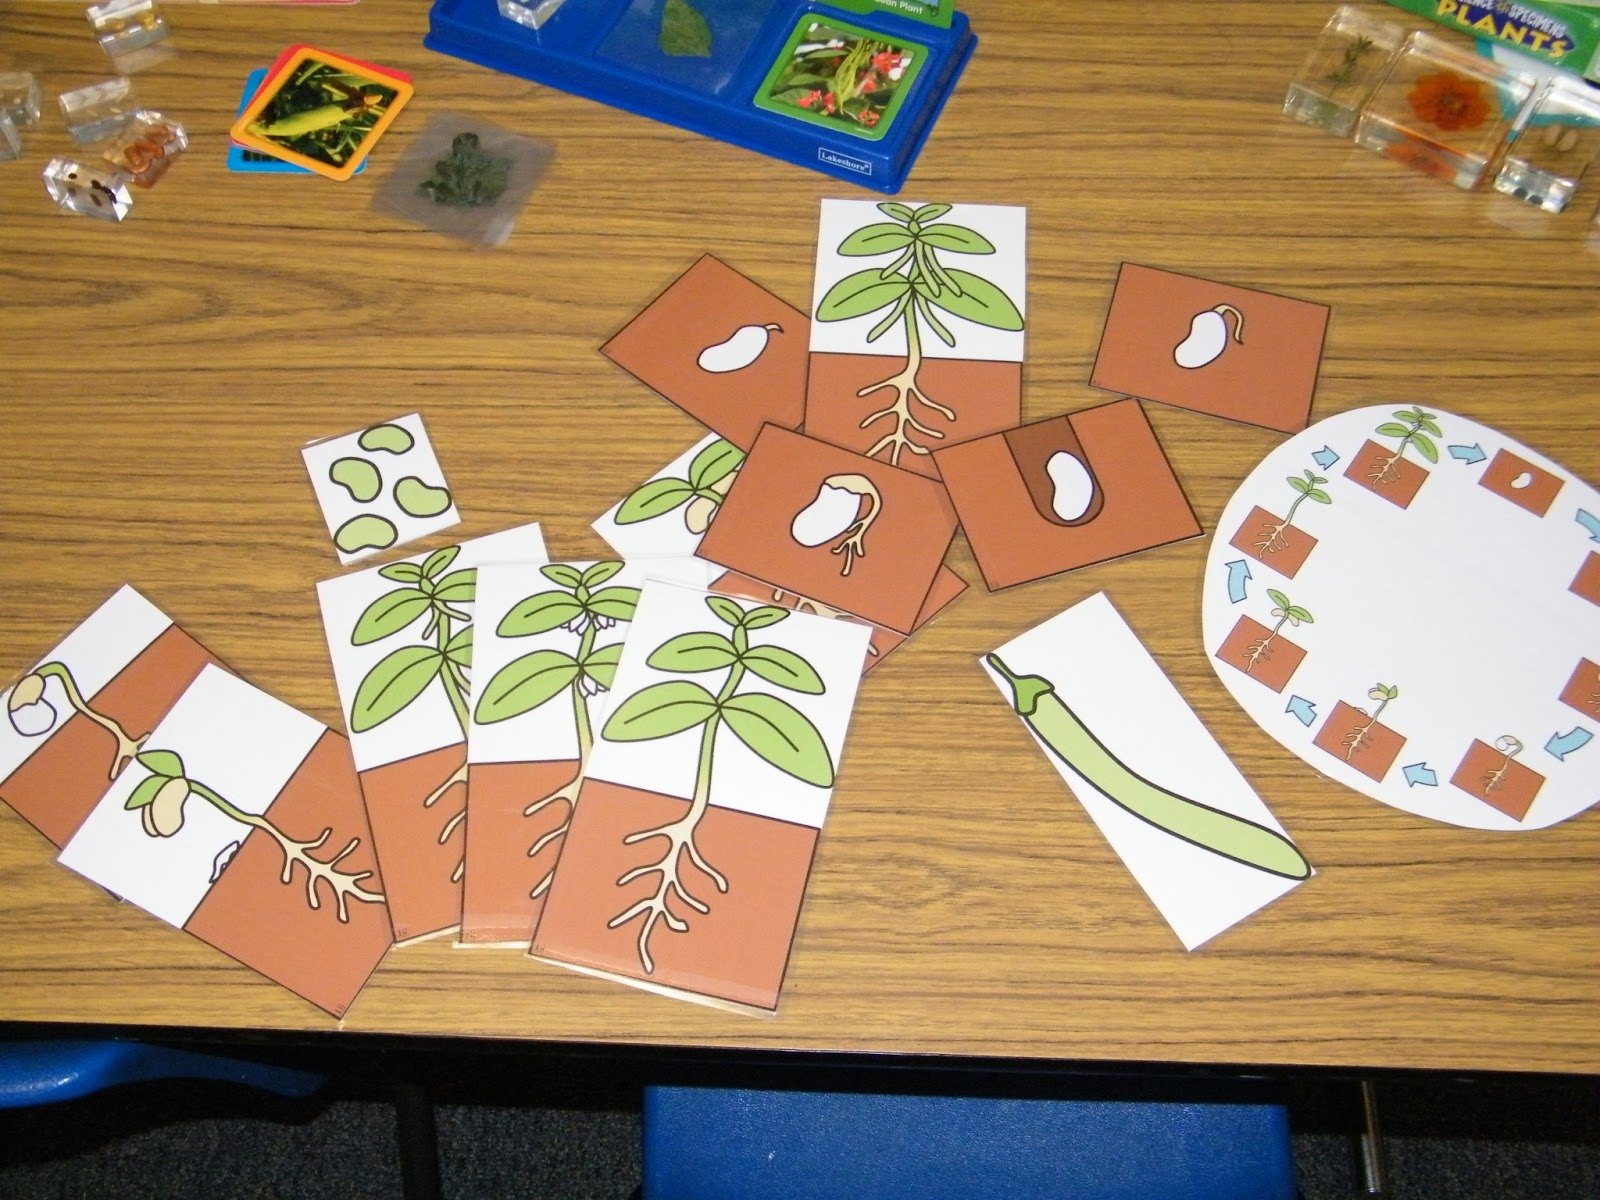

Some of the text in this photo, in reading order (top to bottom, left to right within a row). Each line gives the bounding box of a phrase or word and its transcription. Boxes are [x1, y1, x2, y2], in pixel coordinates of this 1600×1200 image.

[875, 0, 923, 14] ean Plant
[1509, 4, 1567, 38] SPECIMENS
[1436, 0, 1567, 58] PLANTS
